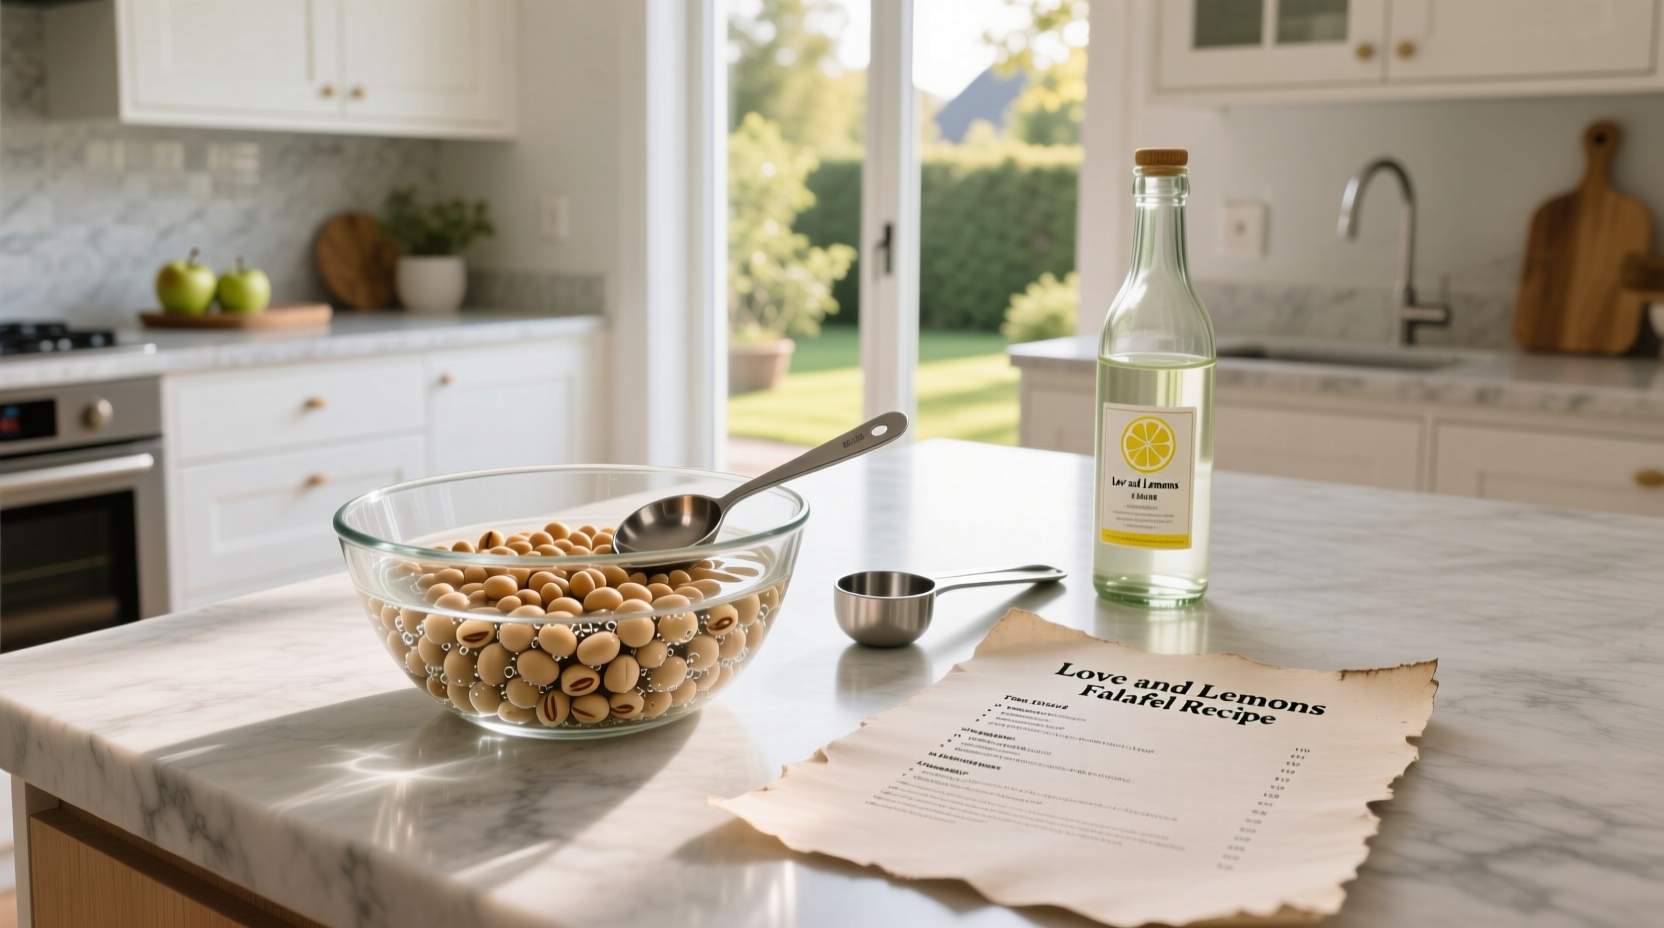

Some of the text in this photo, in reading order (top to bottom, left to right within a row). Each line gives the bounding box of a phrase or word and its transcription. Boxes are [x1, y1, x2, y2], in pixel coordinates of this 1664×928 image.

[1055, 662, 1327, 716] Love and Lemons
[1078, 684, 1177, 710] Falafel
[1179, 699, 1277, 726] Recipe
